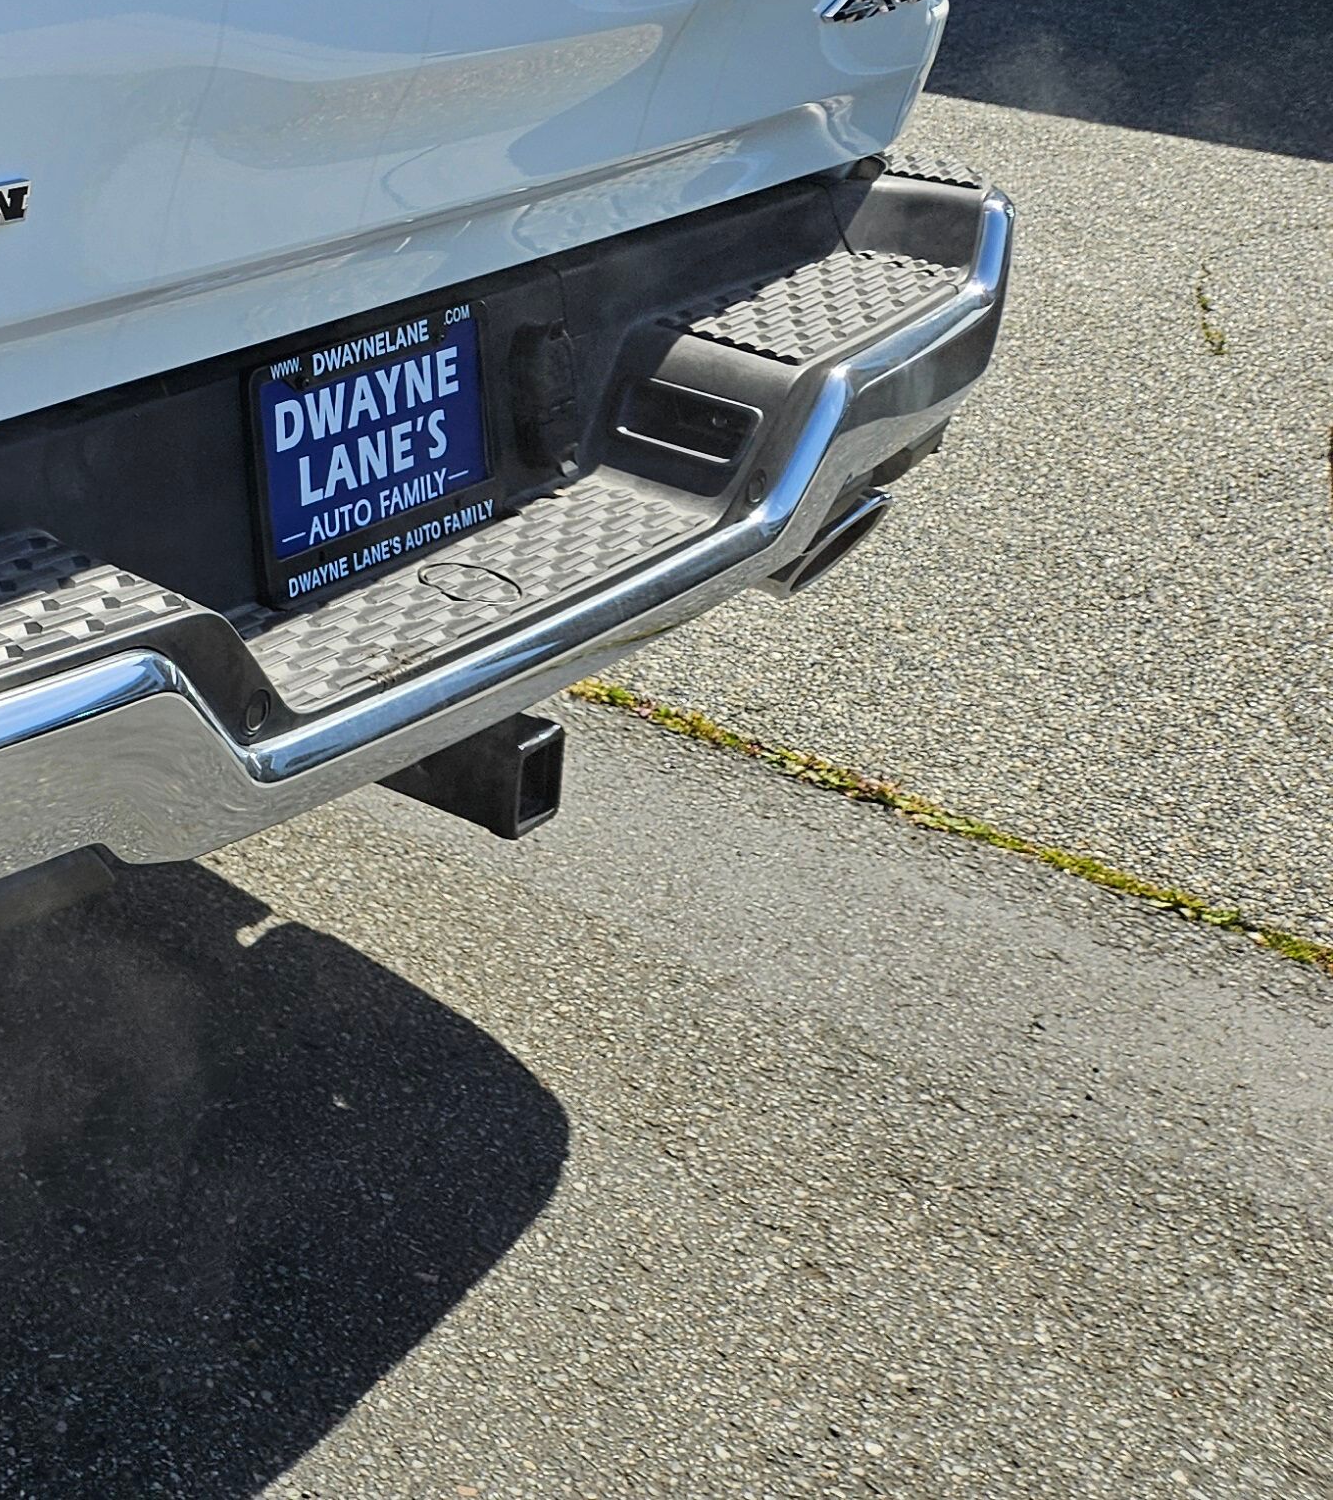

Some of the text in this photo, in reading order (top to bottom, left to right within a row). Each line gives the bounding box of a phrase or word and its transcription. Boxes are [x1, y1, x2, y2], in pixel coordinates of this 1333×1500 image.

[312, 319, 429, 377] DWAYNELANE
[443, 304, 470, 326] .COM
[274, 346, 459, 452] DWAYNE
[299, 409, 448, 507] LANE'S
[308, 468, 450, 545] AUTO FAMILY
[288, 498, 494, 598] DWAYNE LANE'S AUTO FAMILY
